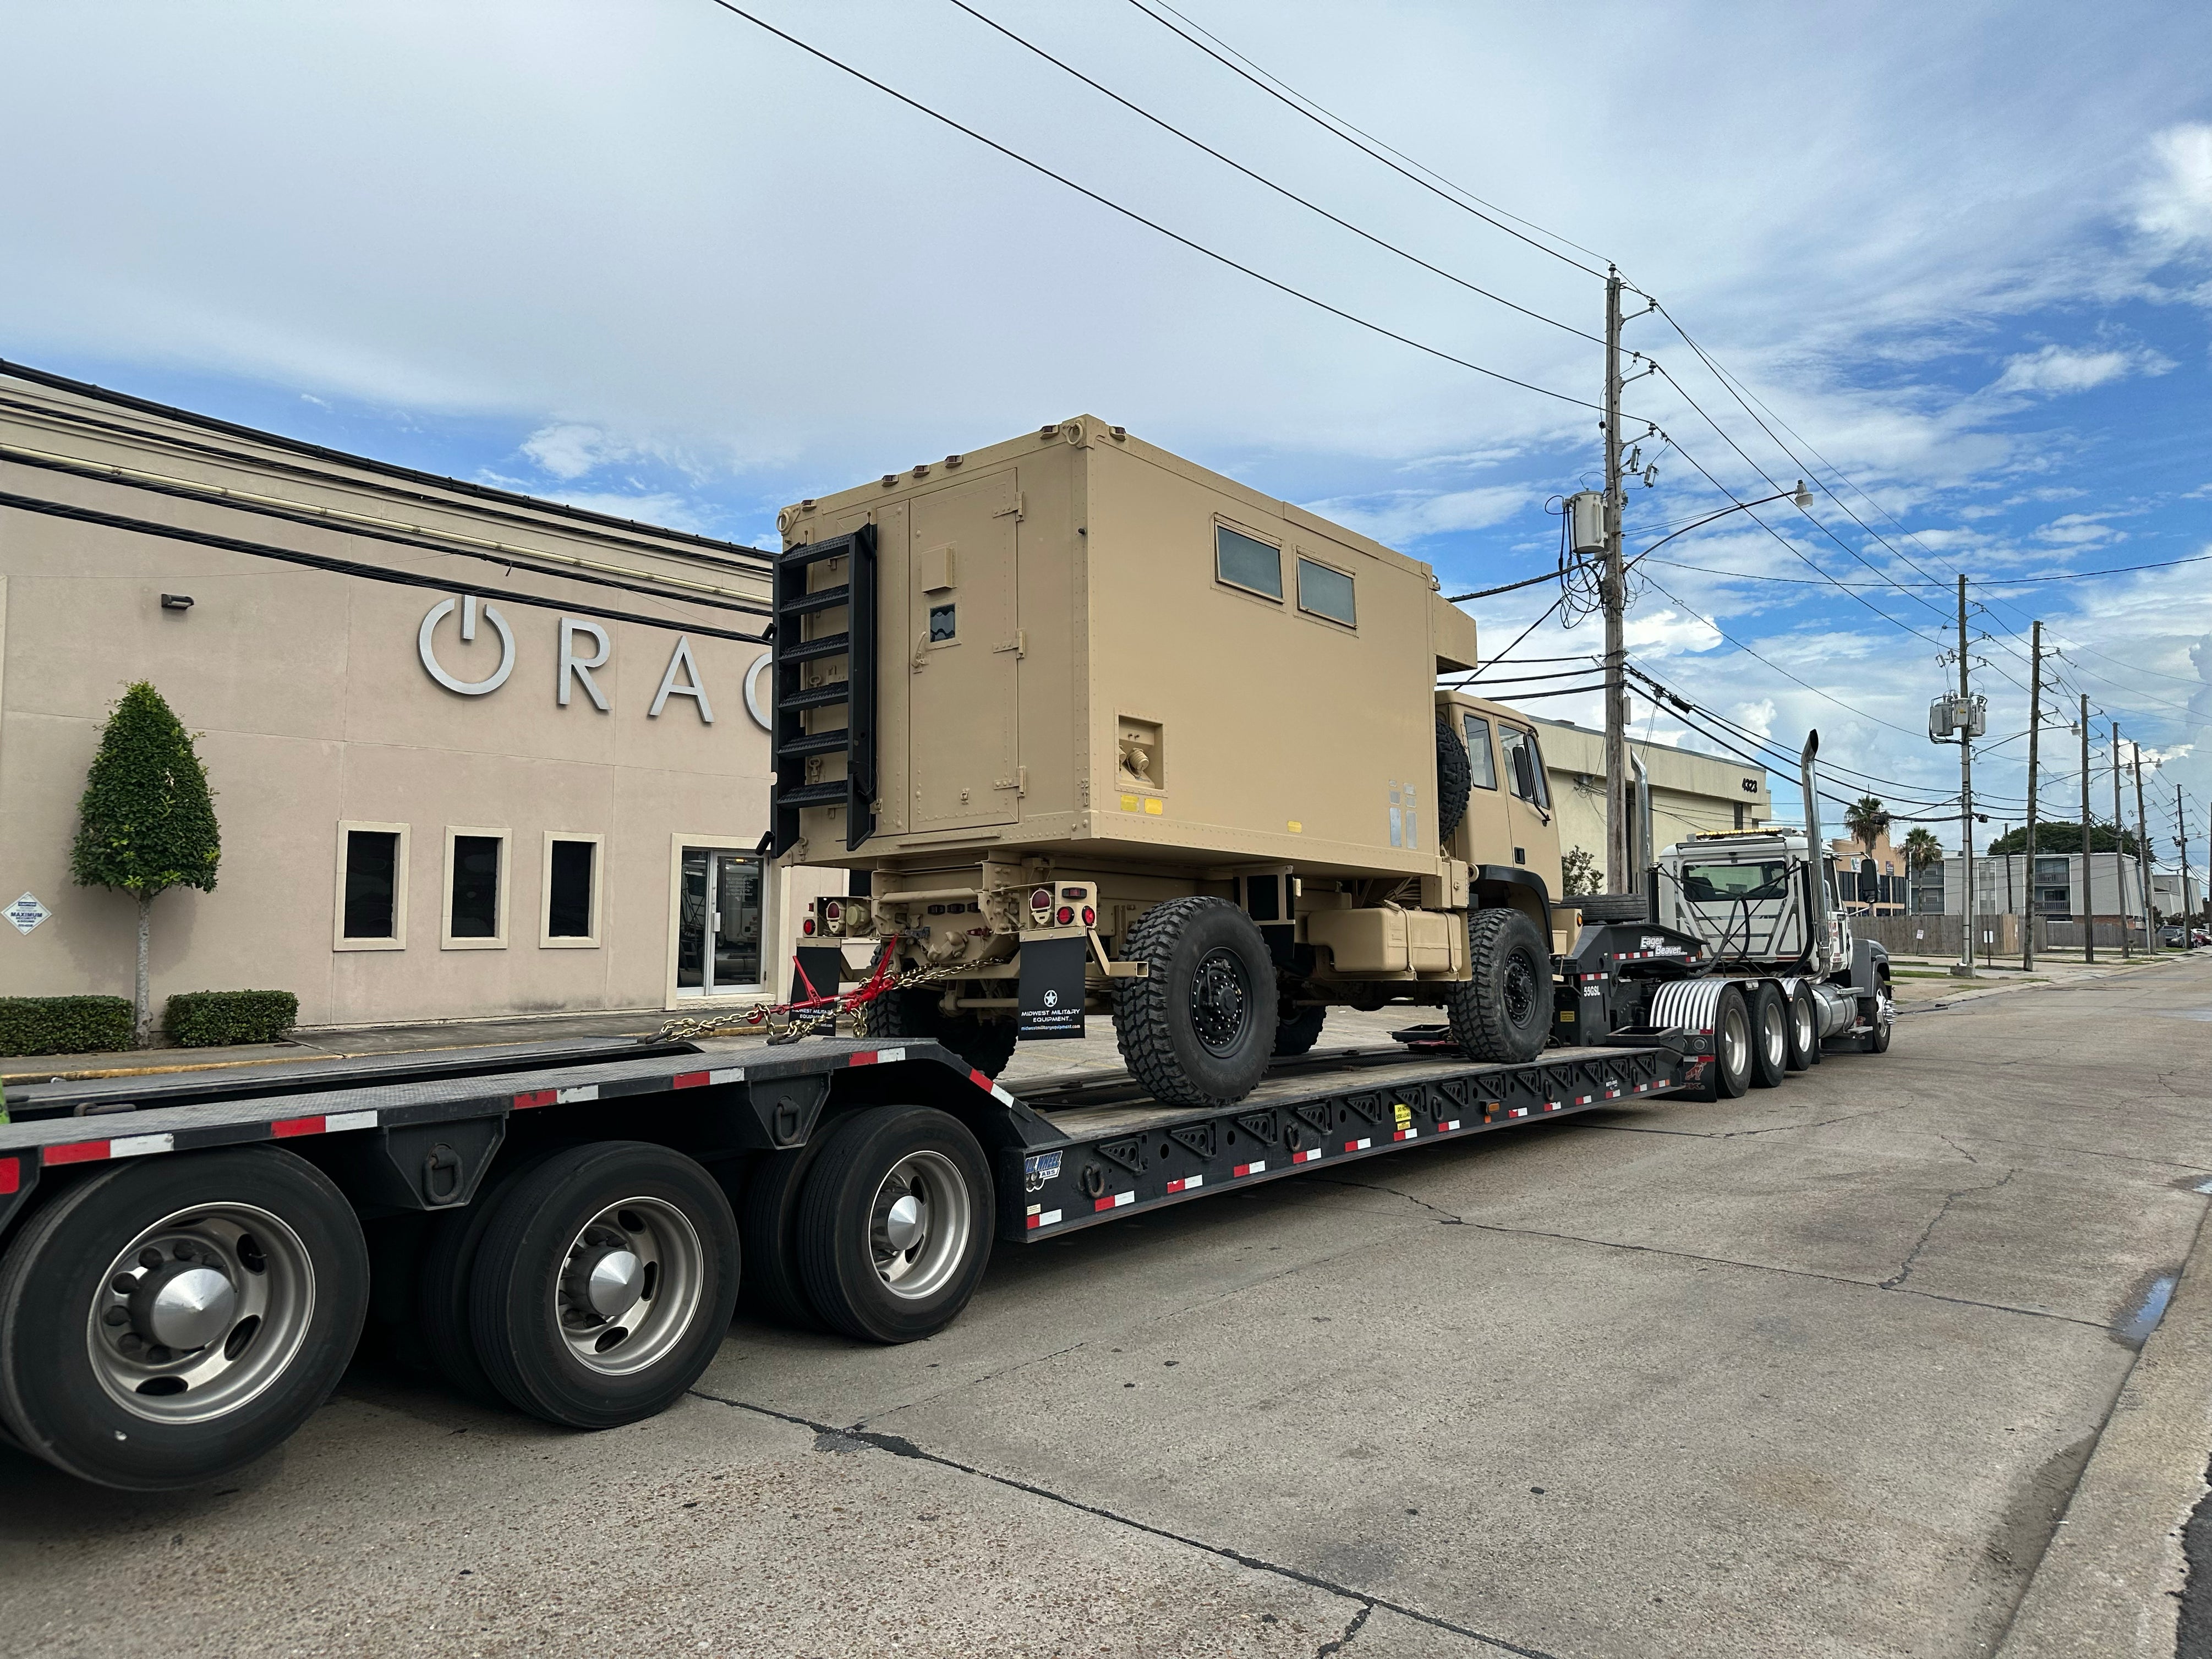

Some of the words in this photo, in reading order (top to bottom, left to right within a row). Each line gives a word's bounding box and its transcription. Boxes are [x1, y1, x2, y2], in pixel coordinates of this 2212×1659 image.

[1742, 778, 1757, 793] 4323
[1640, 937, 1664, 949] Eager
[1655, 945, 1681, 956] Beaver
[1584, 985, 1601, 997] 55GSL
